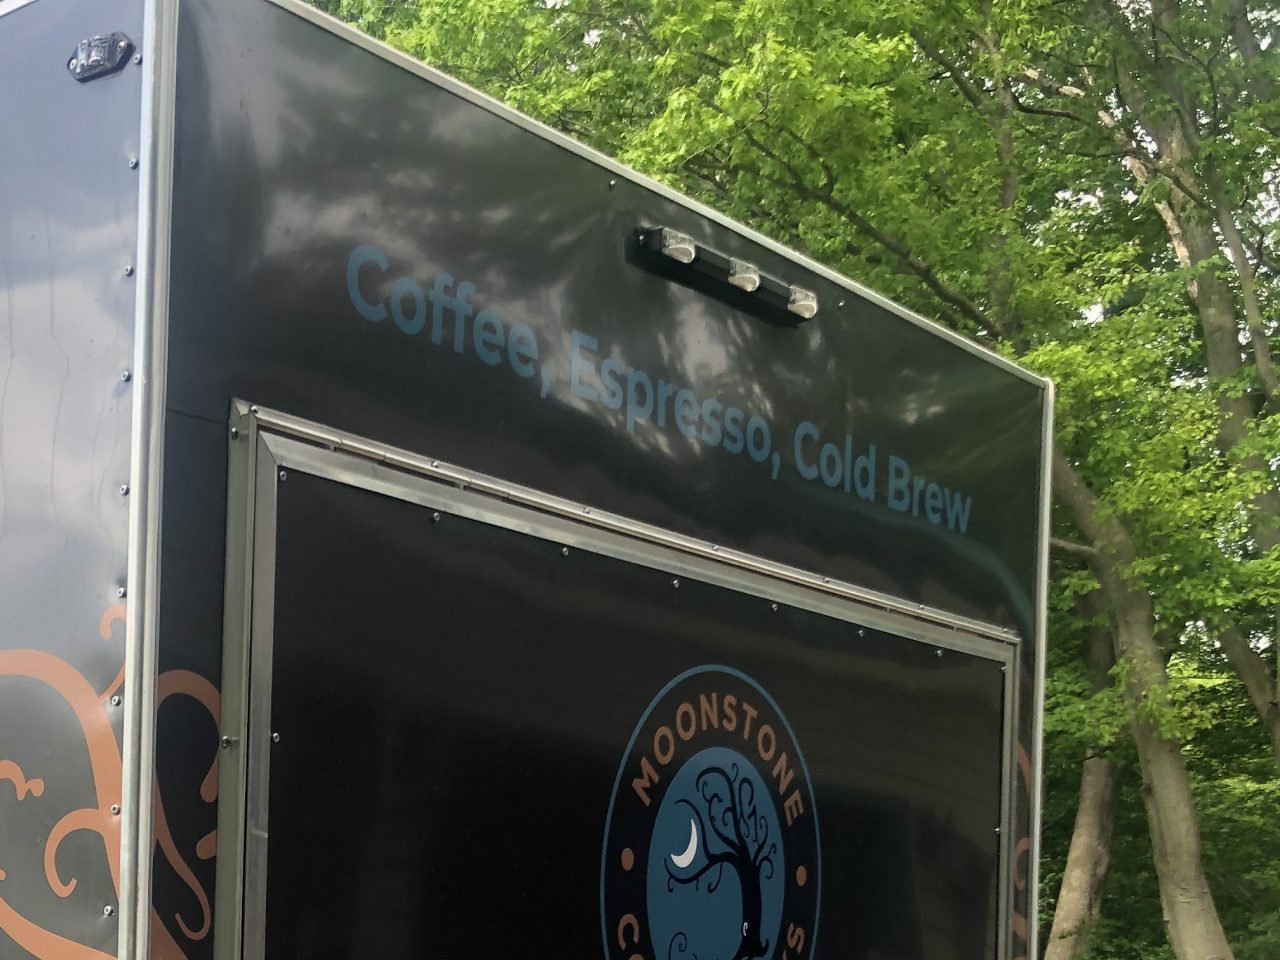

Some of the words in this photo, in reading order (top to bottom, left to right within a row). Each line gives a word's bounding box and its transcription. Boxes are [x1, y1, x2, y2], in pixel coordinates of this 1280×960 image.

[347, 244, 552, 398] Coffee,
[570, 330, 783, 481] Espresso,
[793, 421, 878, 503] Cold
[886, 454, 972, 535] Brew
[631, 692, 805, 828] MOONSTONE
